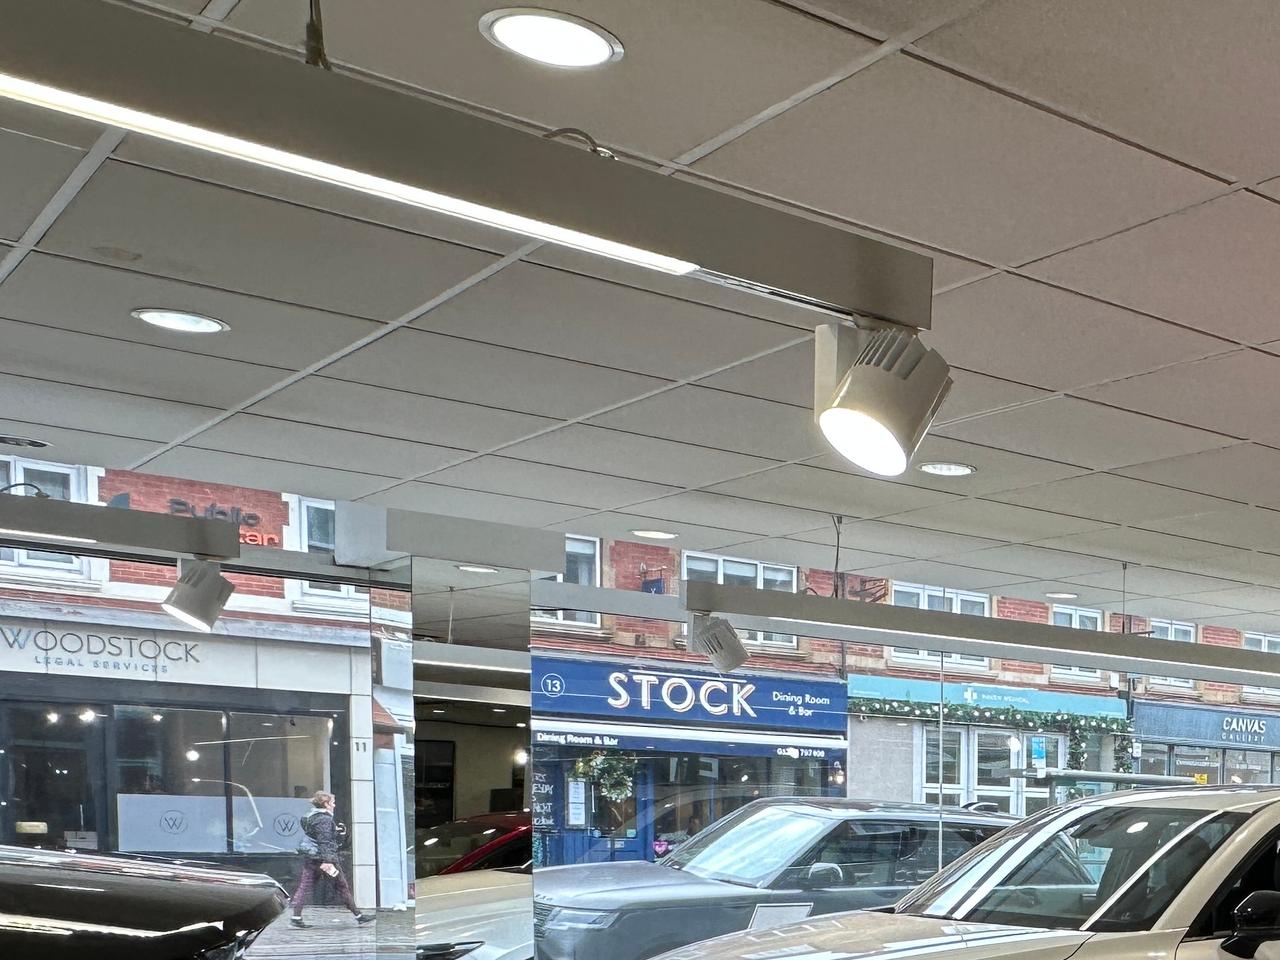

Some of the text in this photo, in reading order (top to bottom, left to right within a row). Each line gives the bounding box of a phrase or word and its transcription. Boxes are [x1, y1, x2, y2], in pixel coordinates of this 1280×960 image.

[0, 627, 200, 663] WOODSTOCK
[34, 655, 168, 673] LEGAL SERVICES
[546, 671, 758, 718] 13 STOCK
[772, 691, 830, 705] Dining Room
[788, 706, 814, 717] & Bar
[1223, 717, 1267, 734] CANVAS
[537, 732, 566, 744] Dining
[567, 734, 593, 745] Room
[603, 736, 618, 746] Bar
[1221, 732, 1265, 742] GALLERY
[355, 741, 367, 752] 11
